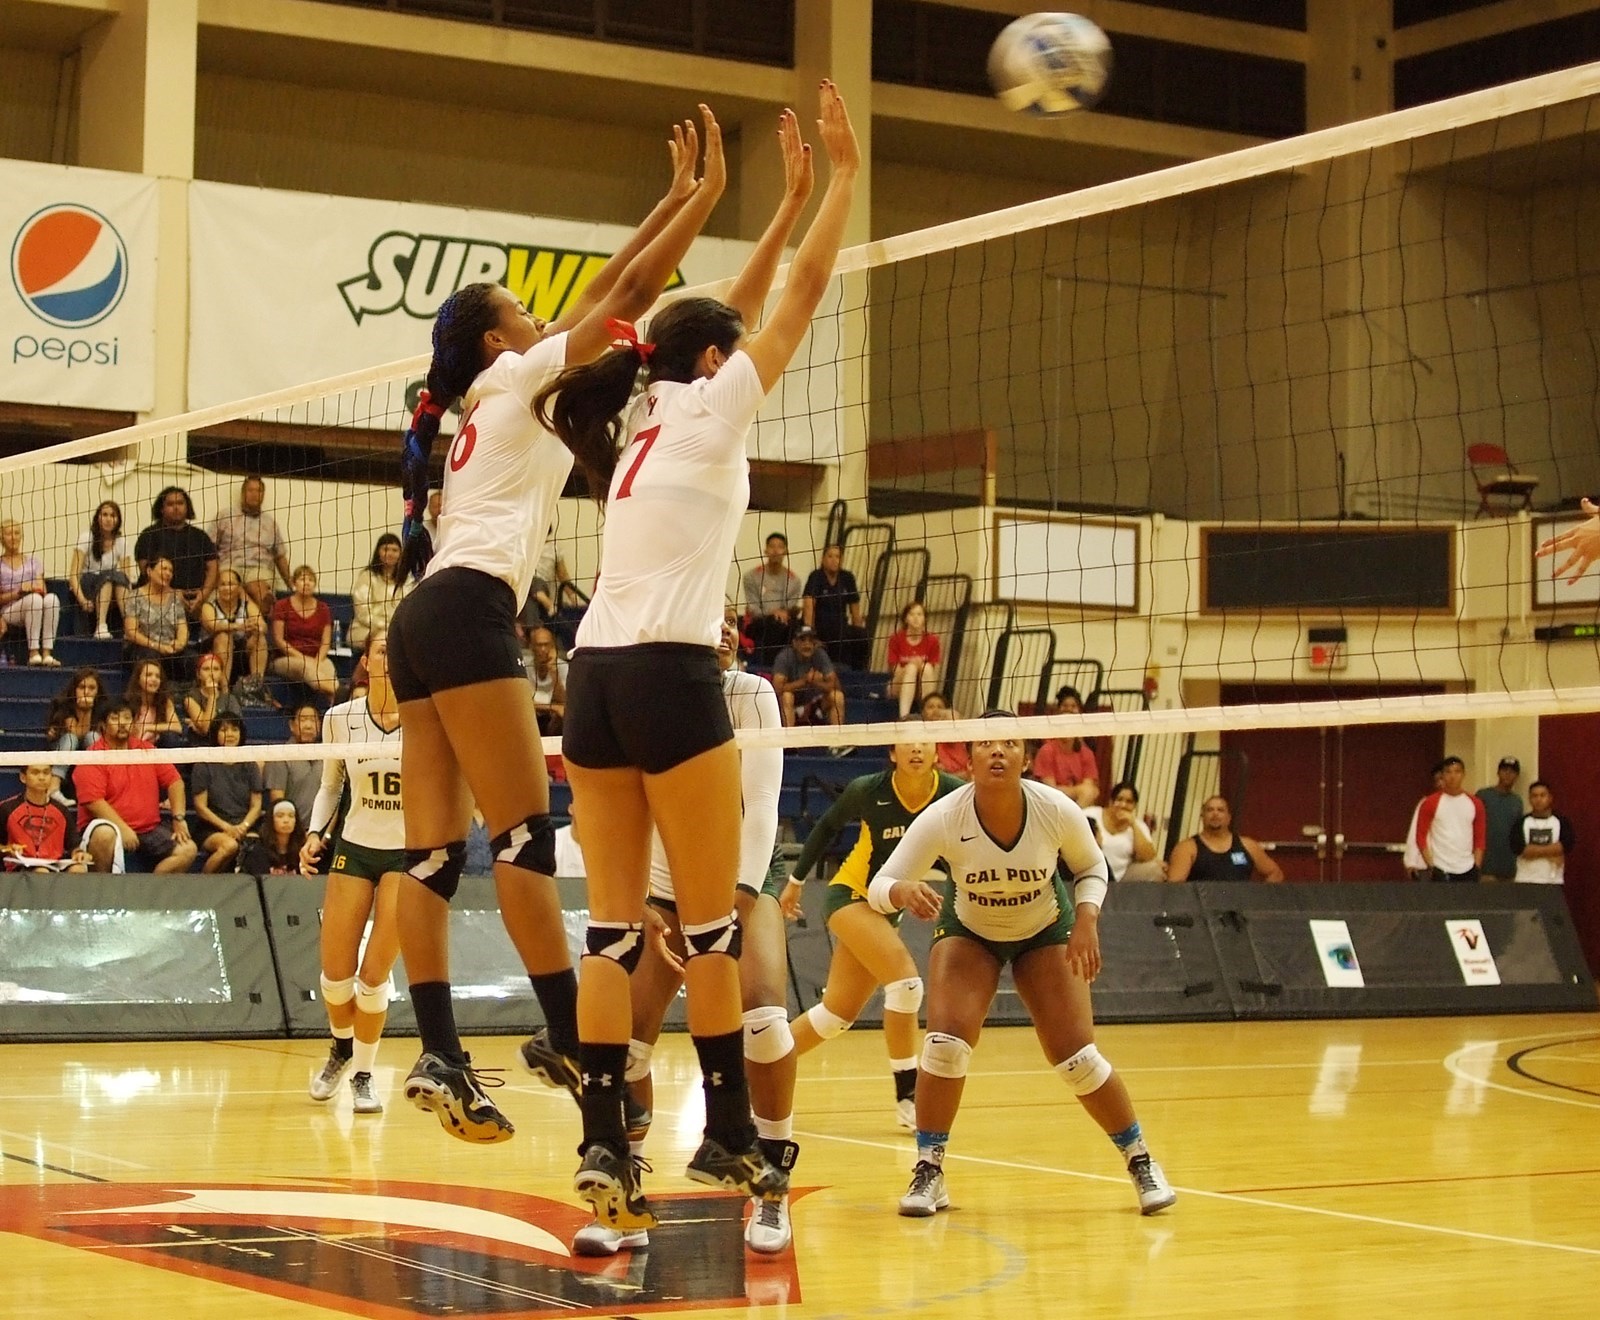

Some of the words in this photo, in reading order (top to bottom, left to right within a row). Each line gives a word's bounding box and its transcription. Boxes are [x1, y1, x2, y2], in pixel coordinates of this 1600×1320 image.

[337, 230, 686, 327] SUBW
[13, 335, 118, 368] pepsi
[450, 400, 480, 472] 6
[615, 423, 661, 500] 7
[368, 771, 401, 796] 16
[361, 797, 404, 811] POMON
[965, 869, 1001, 884] CAL
[1006, 867, 1047, 882] POLY
[968, 888, 1042, 907] POMONA
